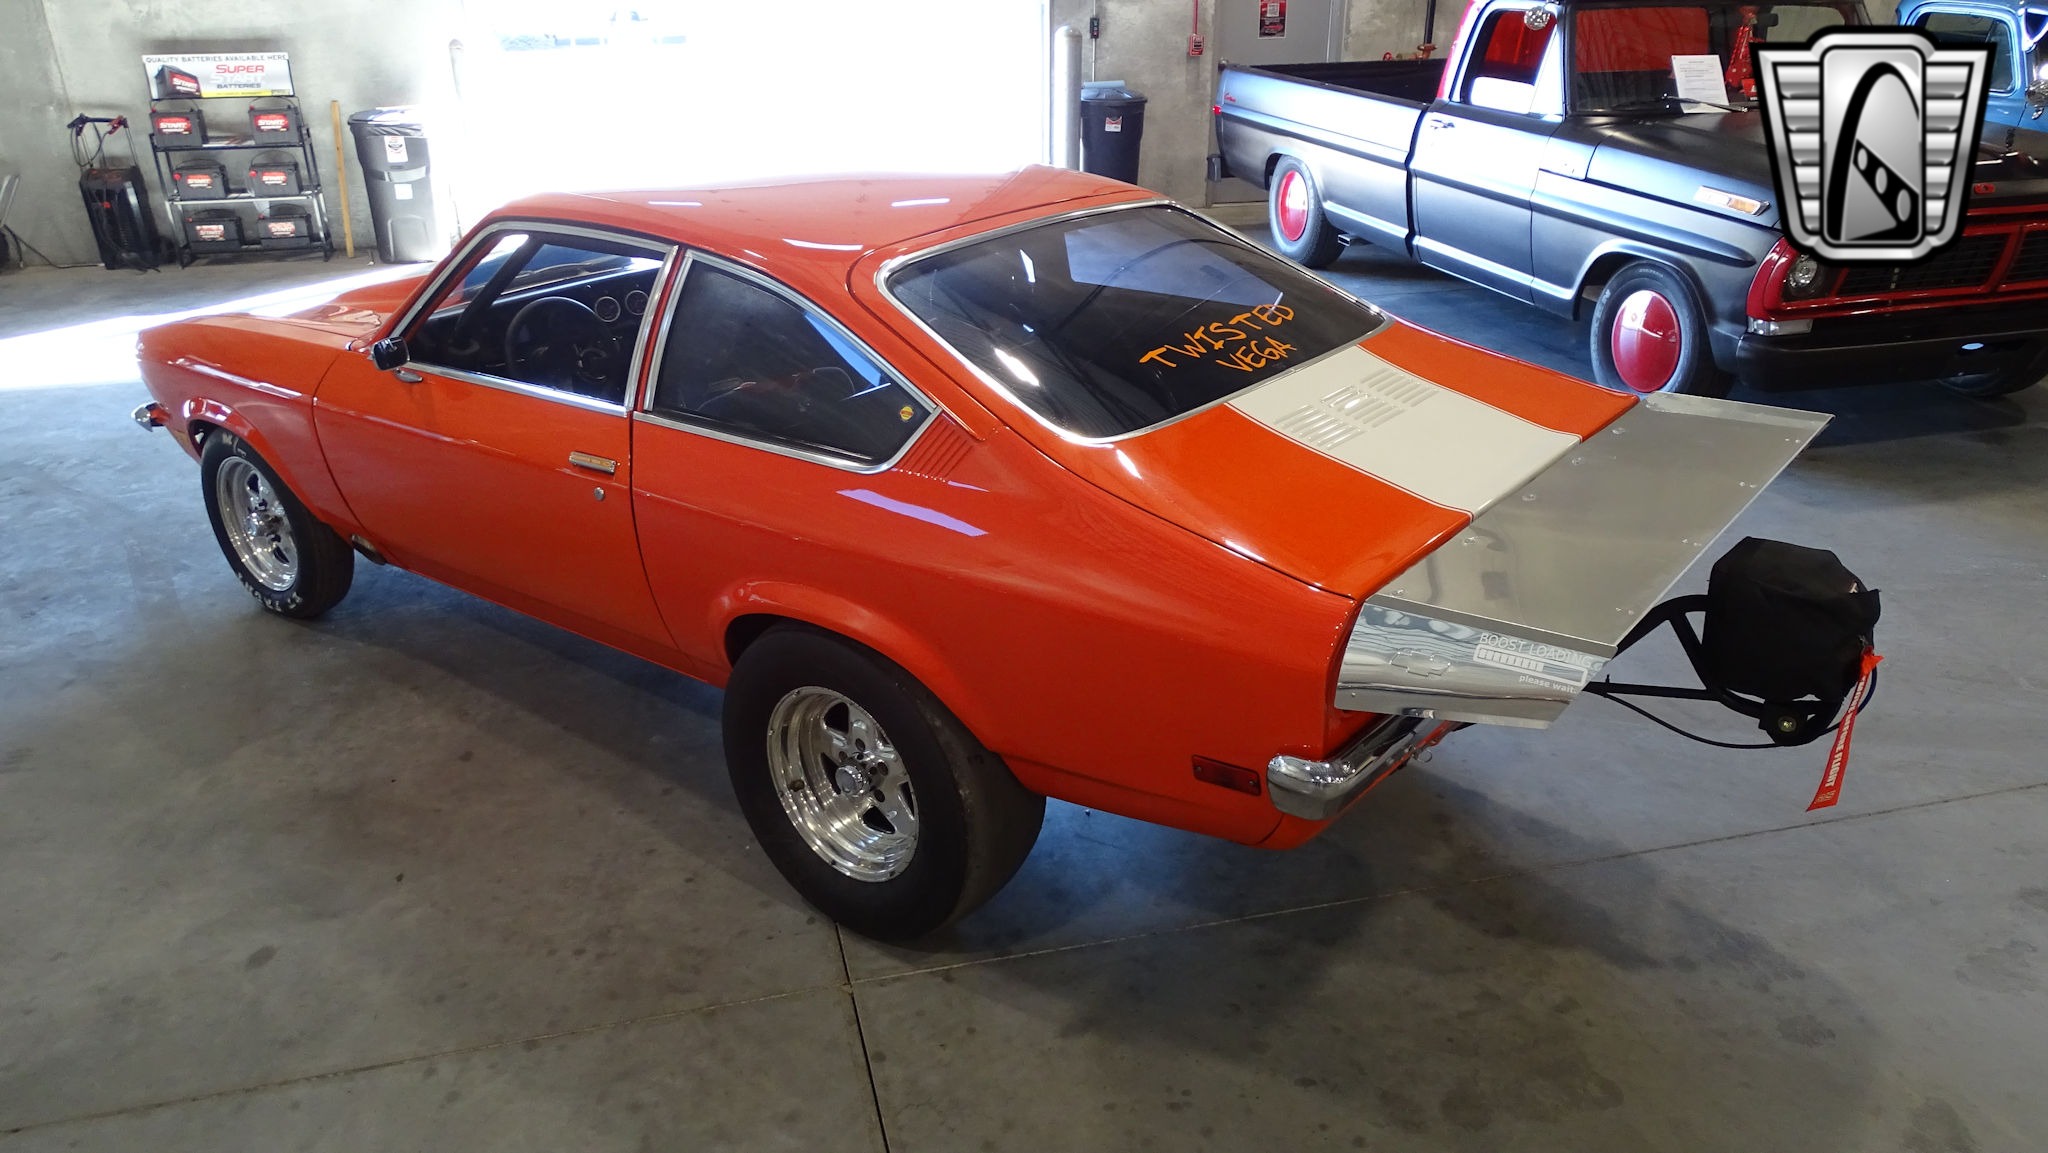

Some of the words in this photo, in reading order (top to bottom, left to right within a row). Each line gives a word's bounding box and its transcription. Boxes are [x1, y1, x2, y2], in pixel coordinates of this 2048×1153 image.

[225, 54, 265, 62] AVAILABLE
[1139, 304, 1295, 368] TWISTED
[1215, 336, 1297, 372] VEGA
[1479, 632, 1526, 652] BOOST
[1519, 674, 1550, 688] please
[1825, 751, 1843, 788] FLIGHT
